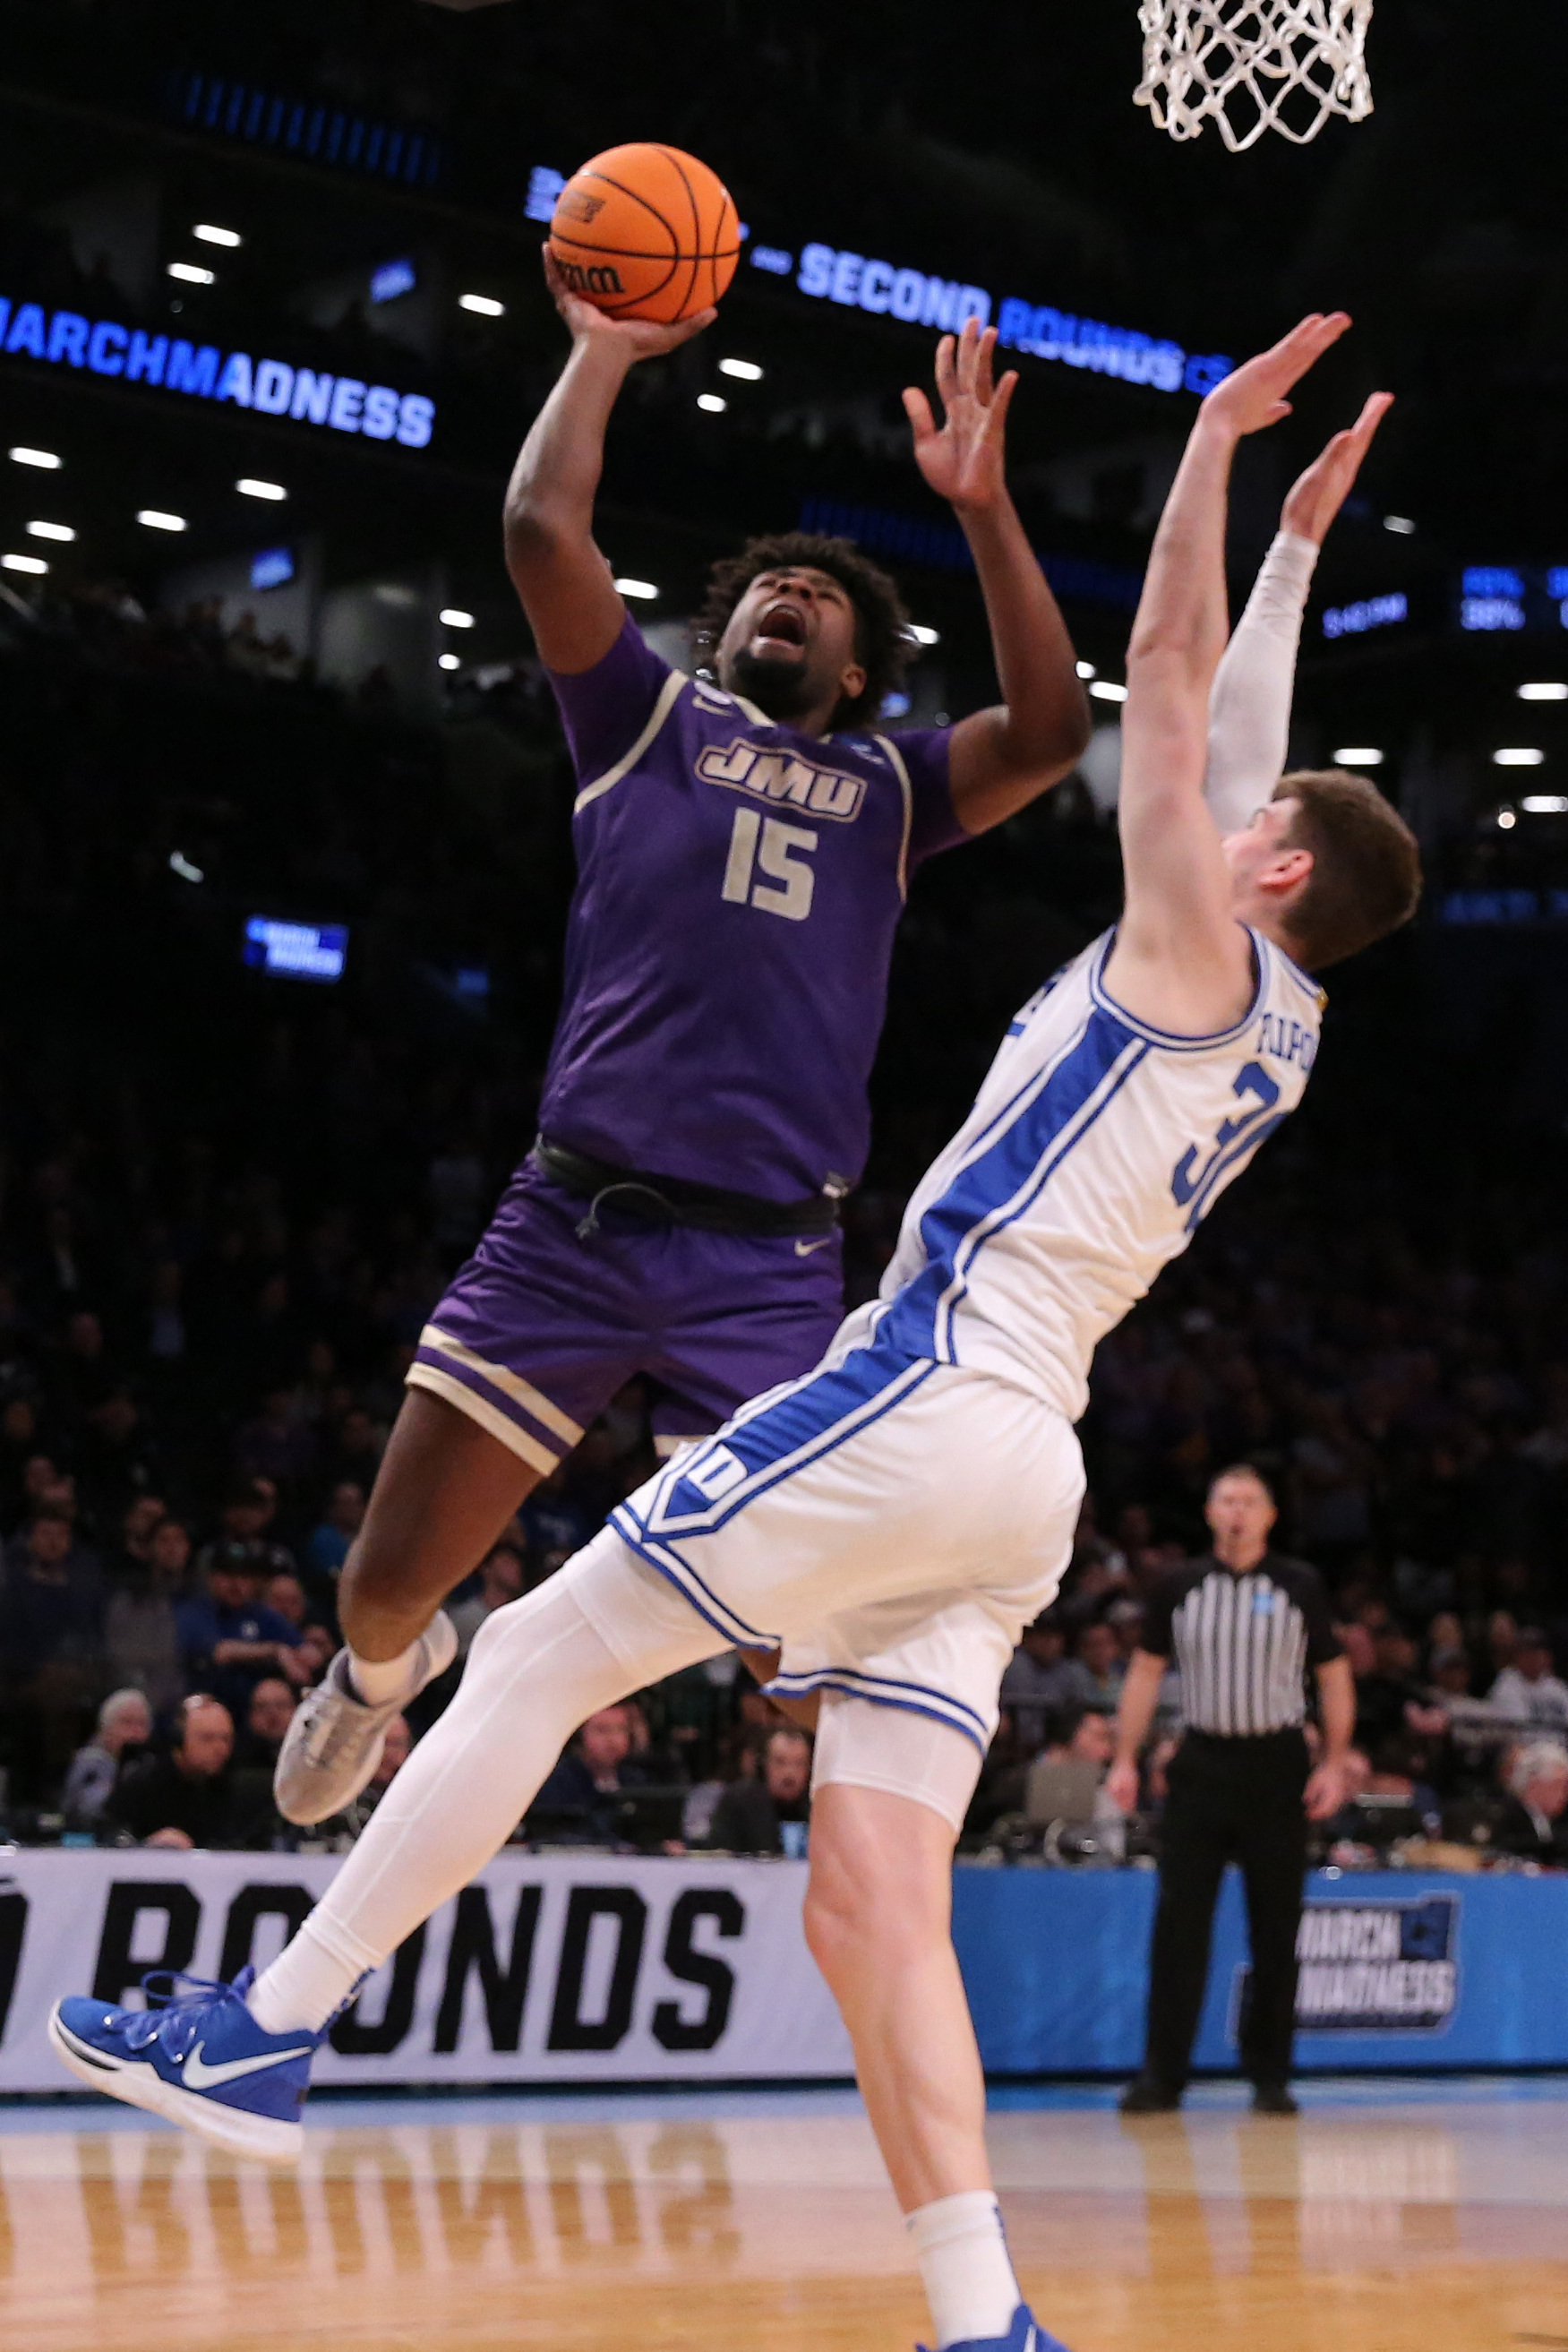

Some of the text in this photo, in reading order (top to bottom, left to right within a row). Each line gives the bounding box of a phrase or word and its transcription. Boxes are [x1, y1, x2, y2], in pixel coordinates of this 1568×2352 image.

[796, 241, 992, 337] SECOND
[0, 296, 437, 448] ARCHMADNESS
[698, 743, 863, 820] JMU
[720, 806, 818, 922] 15
